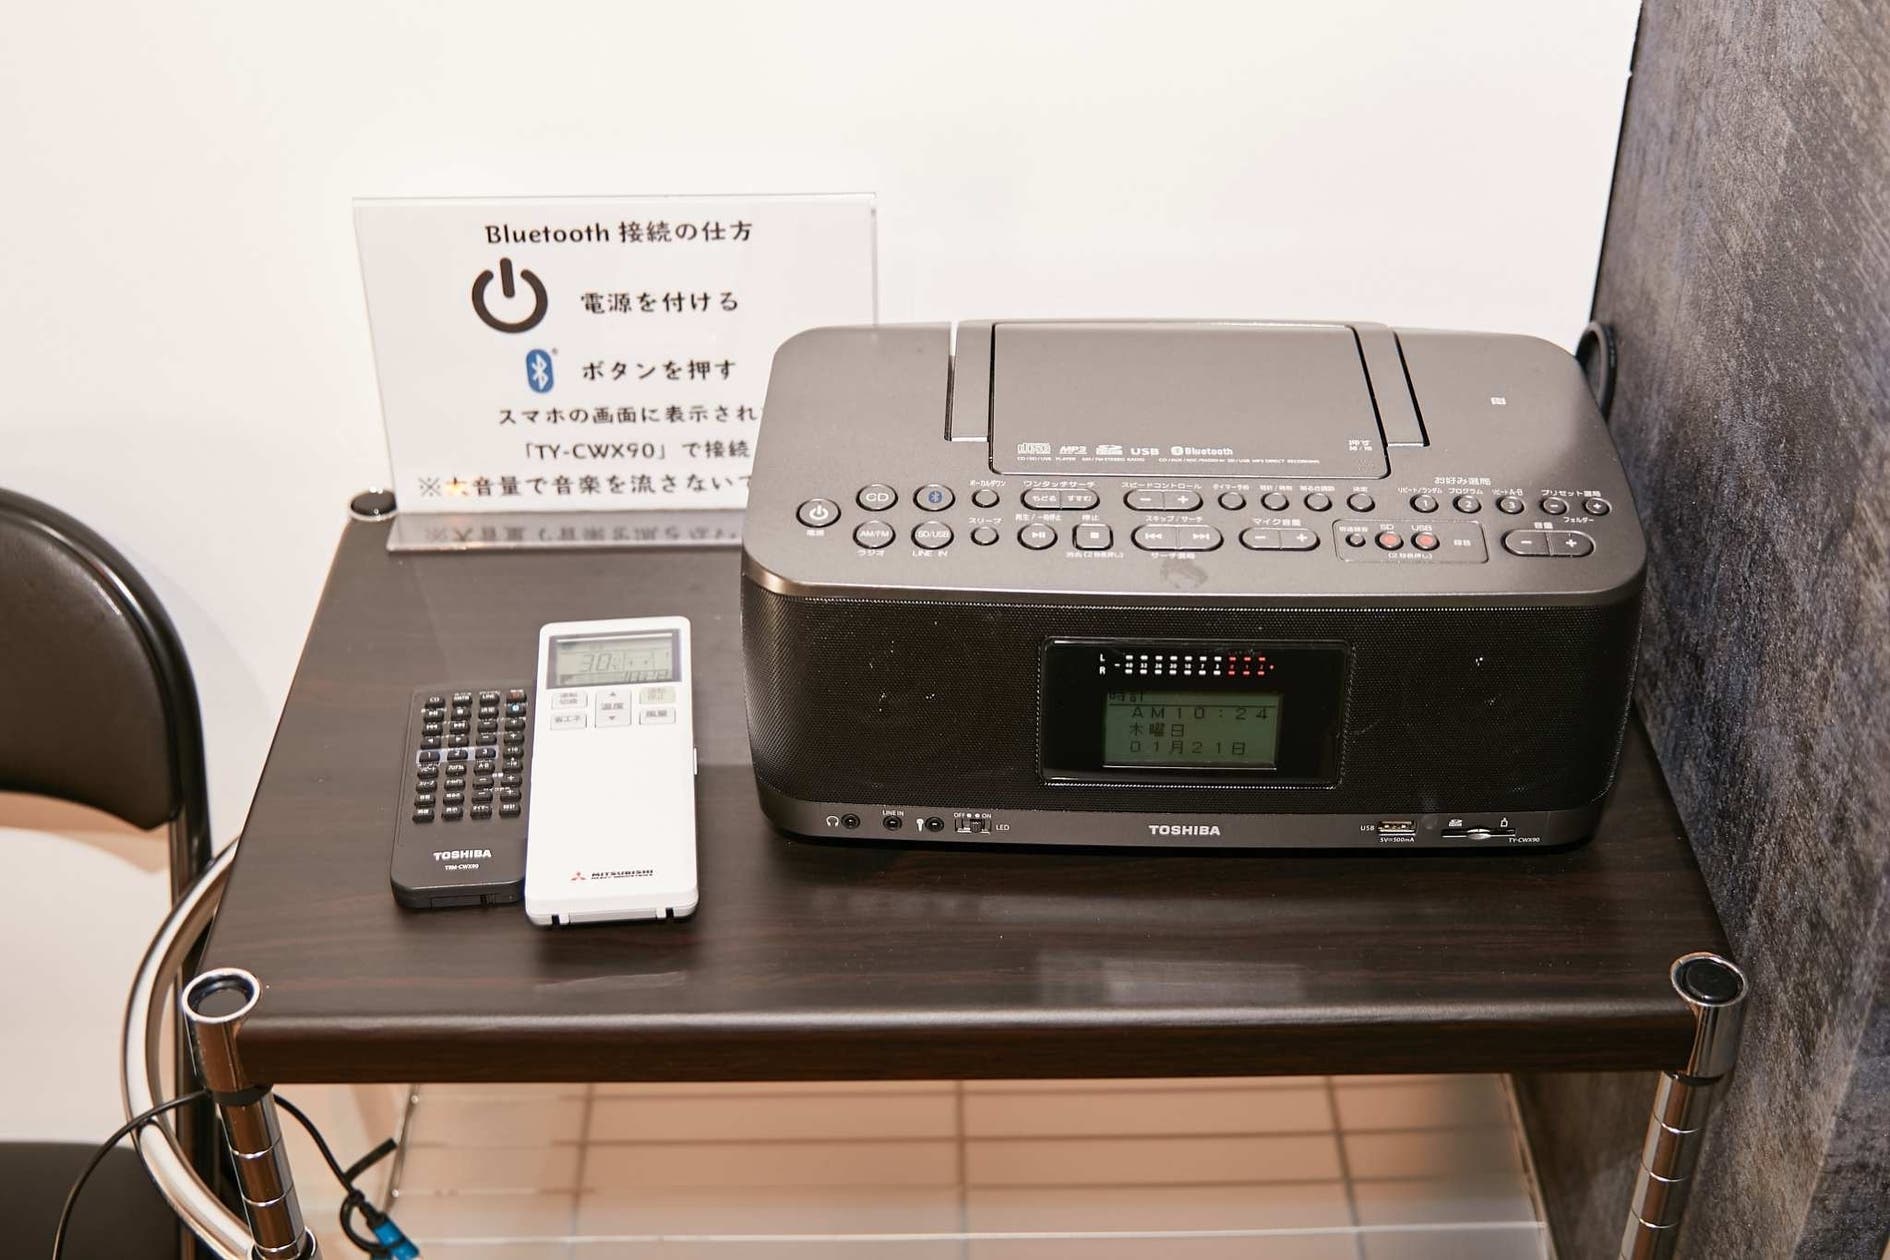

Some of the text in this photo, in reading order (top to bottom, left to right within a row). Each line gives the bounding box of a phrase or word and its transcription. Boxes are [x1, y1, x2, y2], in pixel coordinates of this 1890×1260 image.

[484, 219, 753, 245] Bluetooth 接続の仕方
[580, 291, 739, 315] 電源を付ける
[581, 358, 737, 381] ボタンを押す
[497, 404, 758, 425] スマホの画面に表示され
[1130, 447, 1160, 456] USB
[1184, 446, 1234, 456] Bluetooth
[1023, 480, 1096, 488] ワンタッチサーチ
[866, 492, 889, 502] CD
[968, 517, 1003, 525] スリープ
[1411, 524, 1433, 532] USB
[859, 530, 890, 538] AM/FM
[1099, 654, 1106, 662] L
[1099, 666, 1106, 675] R
[1148, 825, 1221, 836] TOSHIBA
[433, 849, 492, 861] TOSHIBA
